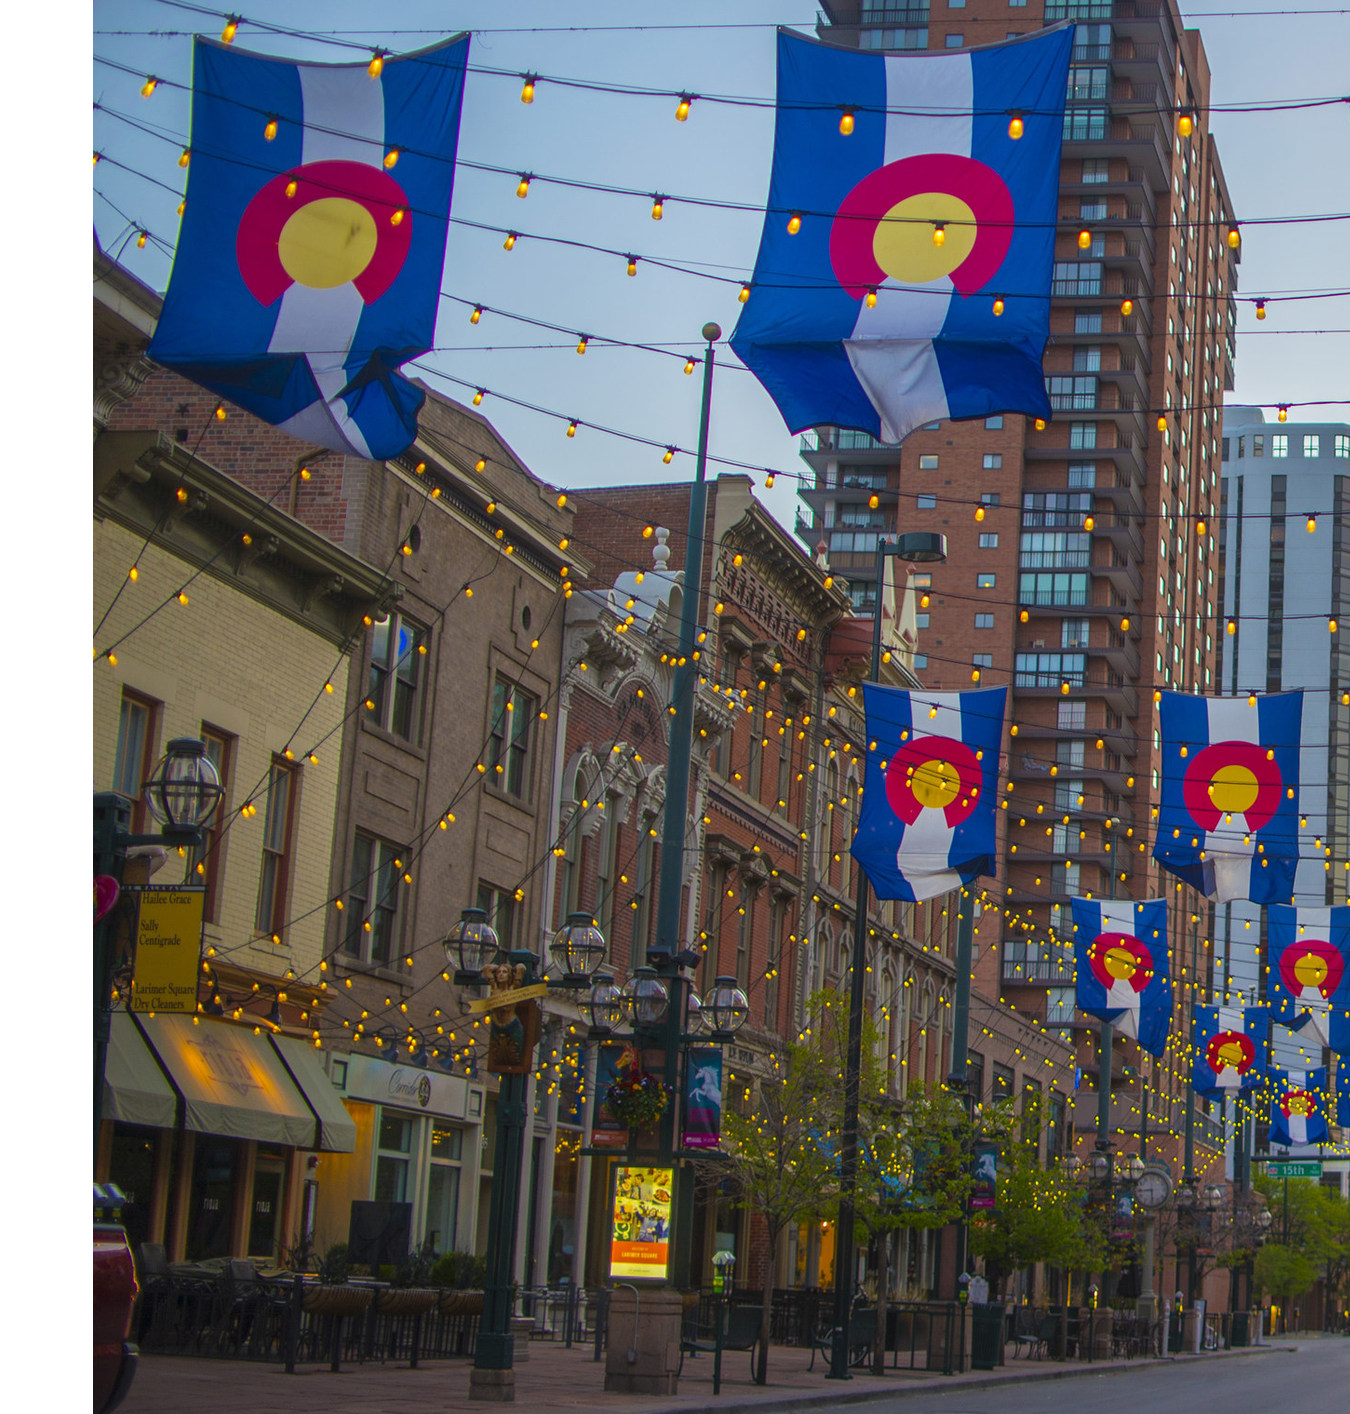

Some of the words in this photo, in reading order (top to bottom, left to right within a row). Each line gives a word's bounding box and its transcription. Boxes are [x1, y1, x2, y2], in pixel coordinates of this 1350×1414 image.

[142, 893, 168, 904] Hailee
[169, 892, 192, 904] Grace
[140, 919, 159, 931] Sally
[139, 934, 181, 947] Centigrade
[135, 983, 166, 994] Larimer
[168, 982, 195, 996] Square
[134, 998, 149, 1011] Dry
[151, 998, 185, 1009] Cleaners
[1282, 1165, 1305, 1175] 15th
